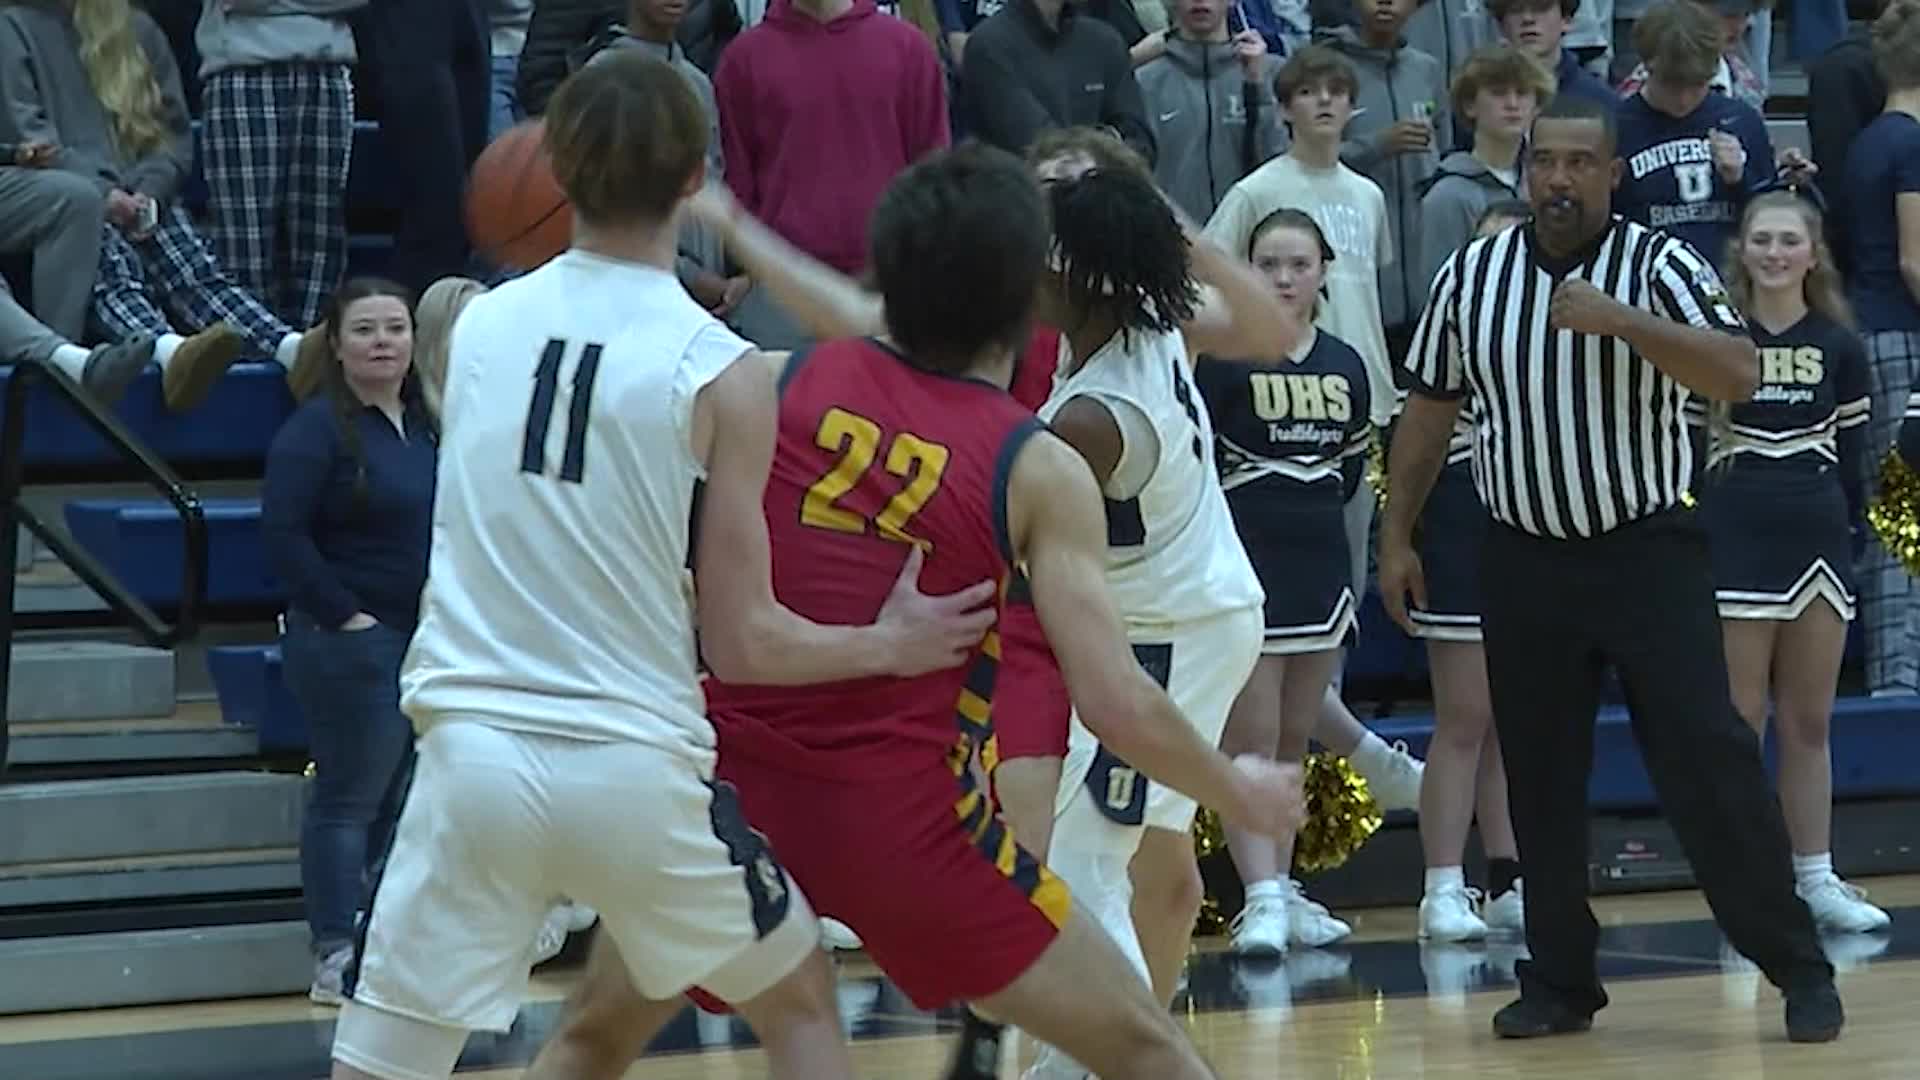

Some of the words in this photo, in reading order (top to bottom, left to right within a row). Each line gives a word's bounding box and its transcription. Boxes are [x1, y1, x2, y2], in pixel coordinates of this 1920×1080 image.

[1674, 161, 1713, 201] U
[1755, 346, 1824, 385] HS
[520, 338, 604, 485] 11
[1249, 372, 1351, 423] UHS
[799, 405, 952, 553] 22
